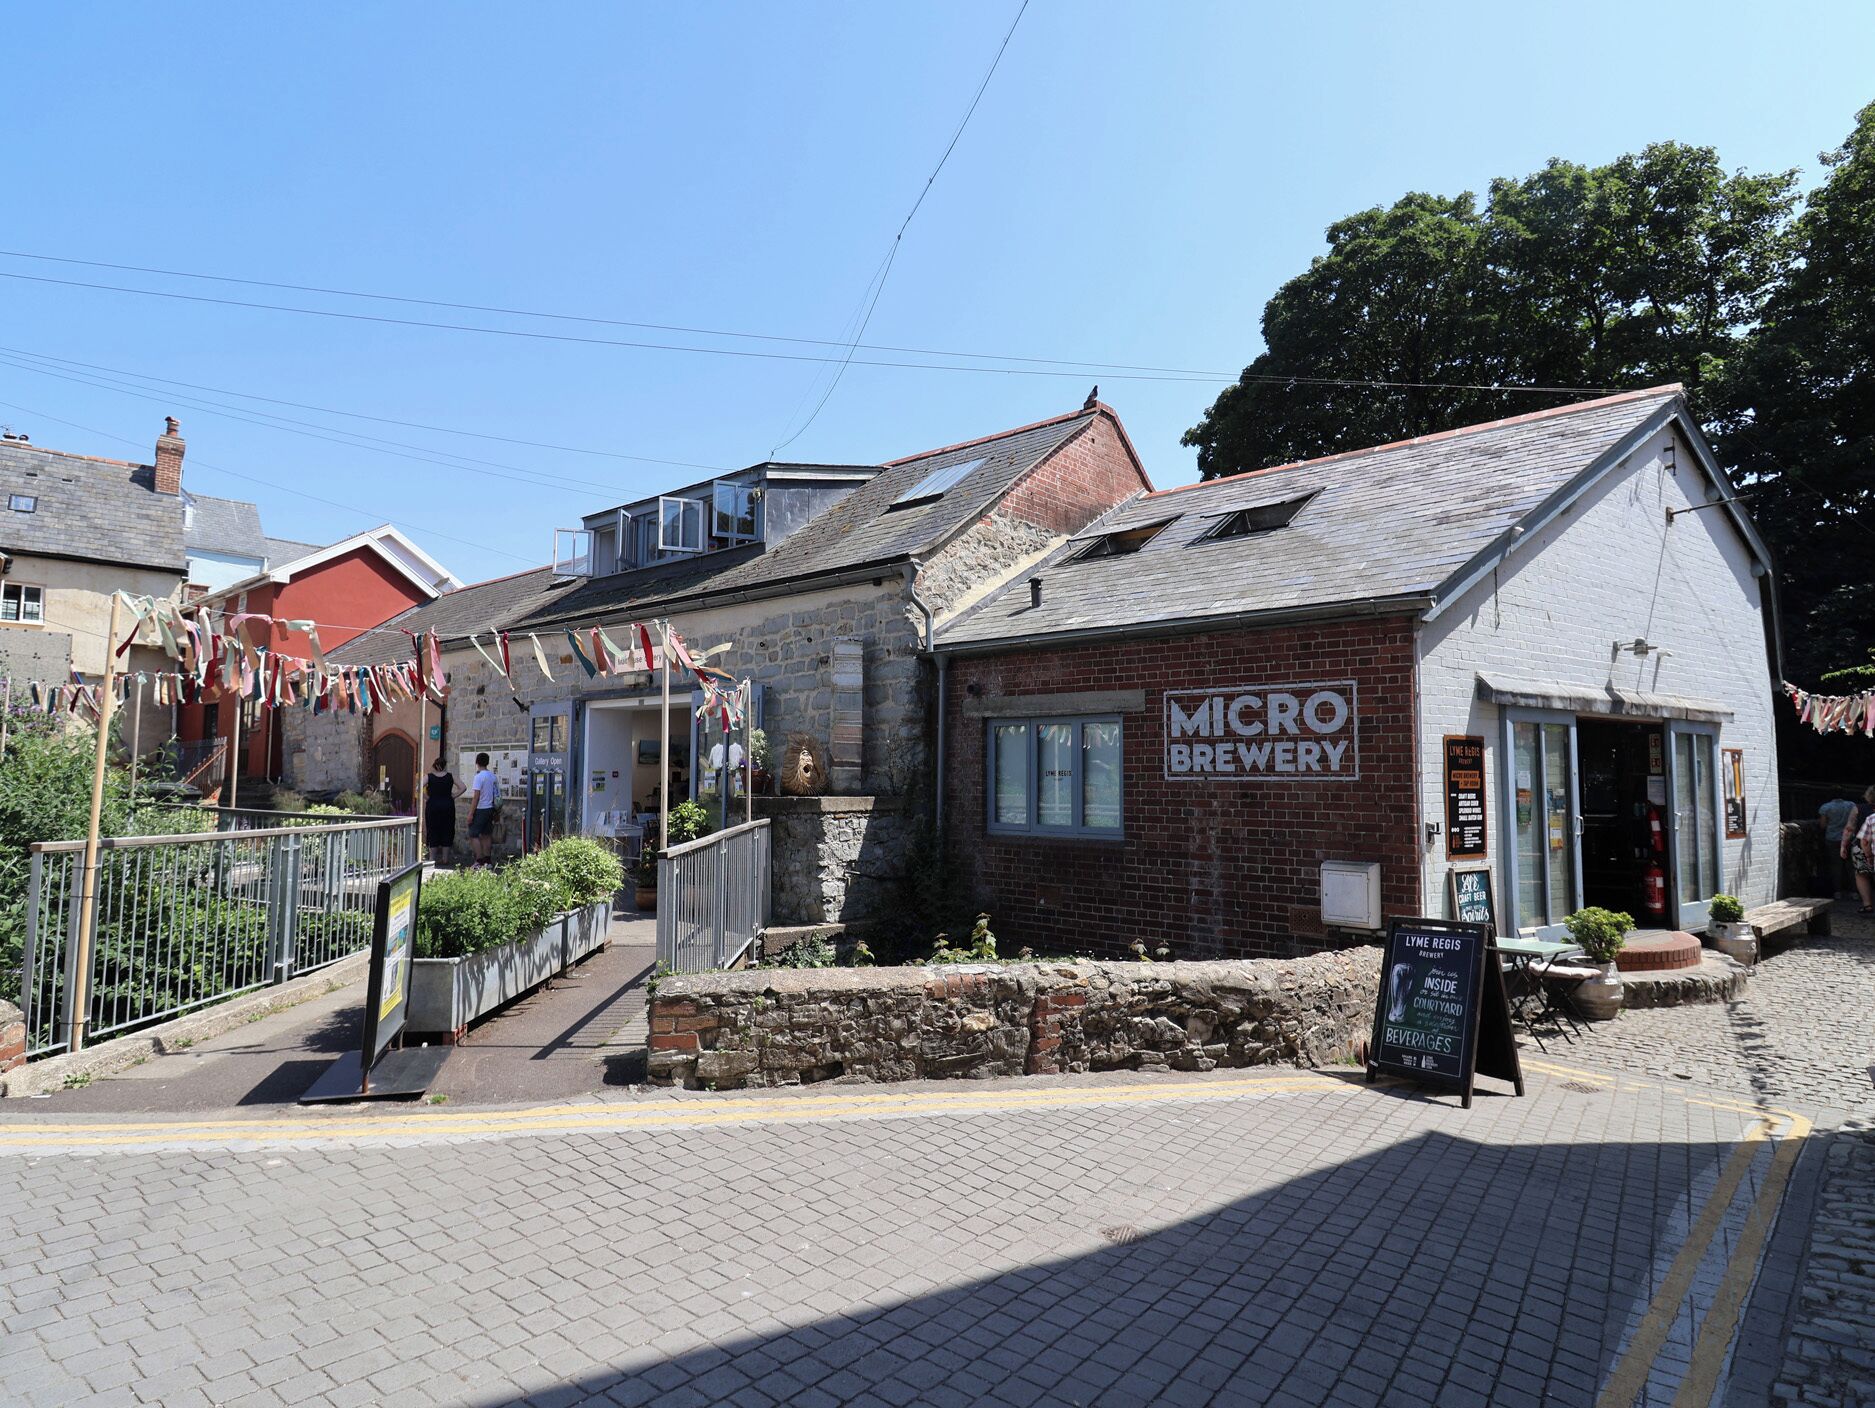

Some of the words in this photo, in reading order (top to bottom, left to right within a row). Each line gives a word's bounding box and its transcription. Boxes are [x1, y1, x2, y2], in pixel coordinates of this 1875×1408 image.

[1170, 690, 1348, 738] MICRO
[1170, 740, 1349, 773] BREWERY
[1449, 745, 1464, 757] LYME
[1465, 745, 1480, 757] REGIS
[535, 757, 549, 767] Gallery
[550, 756, 562, 766] Open
[1474, 891, 1487, 901] BEER
[1405, 935, 1430, 948] LYME
[1432, 937, 1461, 951] REGIS
[1418, 950, 1444, 959] BREWERY
[1424, 976, 1458, 994] INSIDE
[1413, 996, 1463, 1017] COURTYARD
[1385, 1027, 1452, 1053] BEVERAGES
